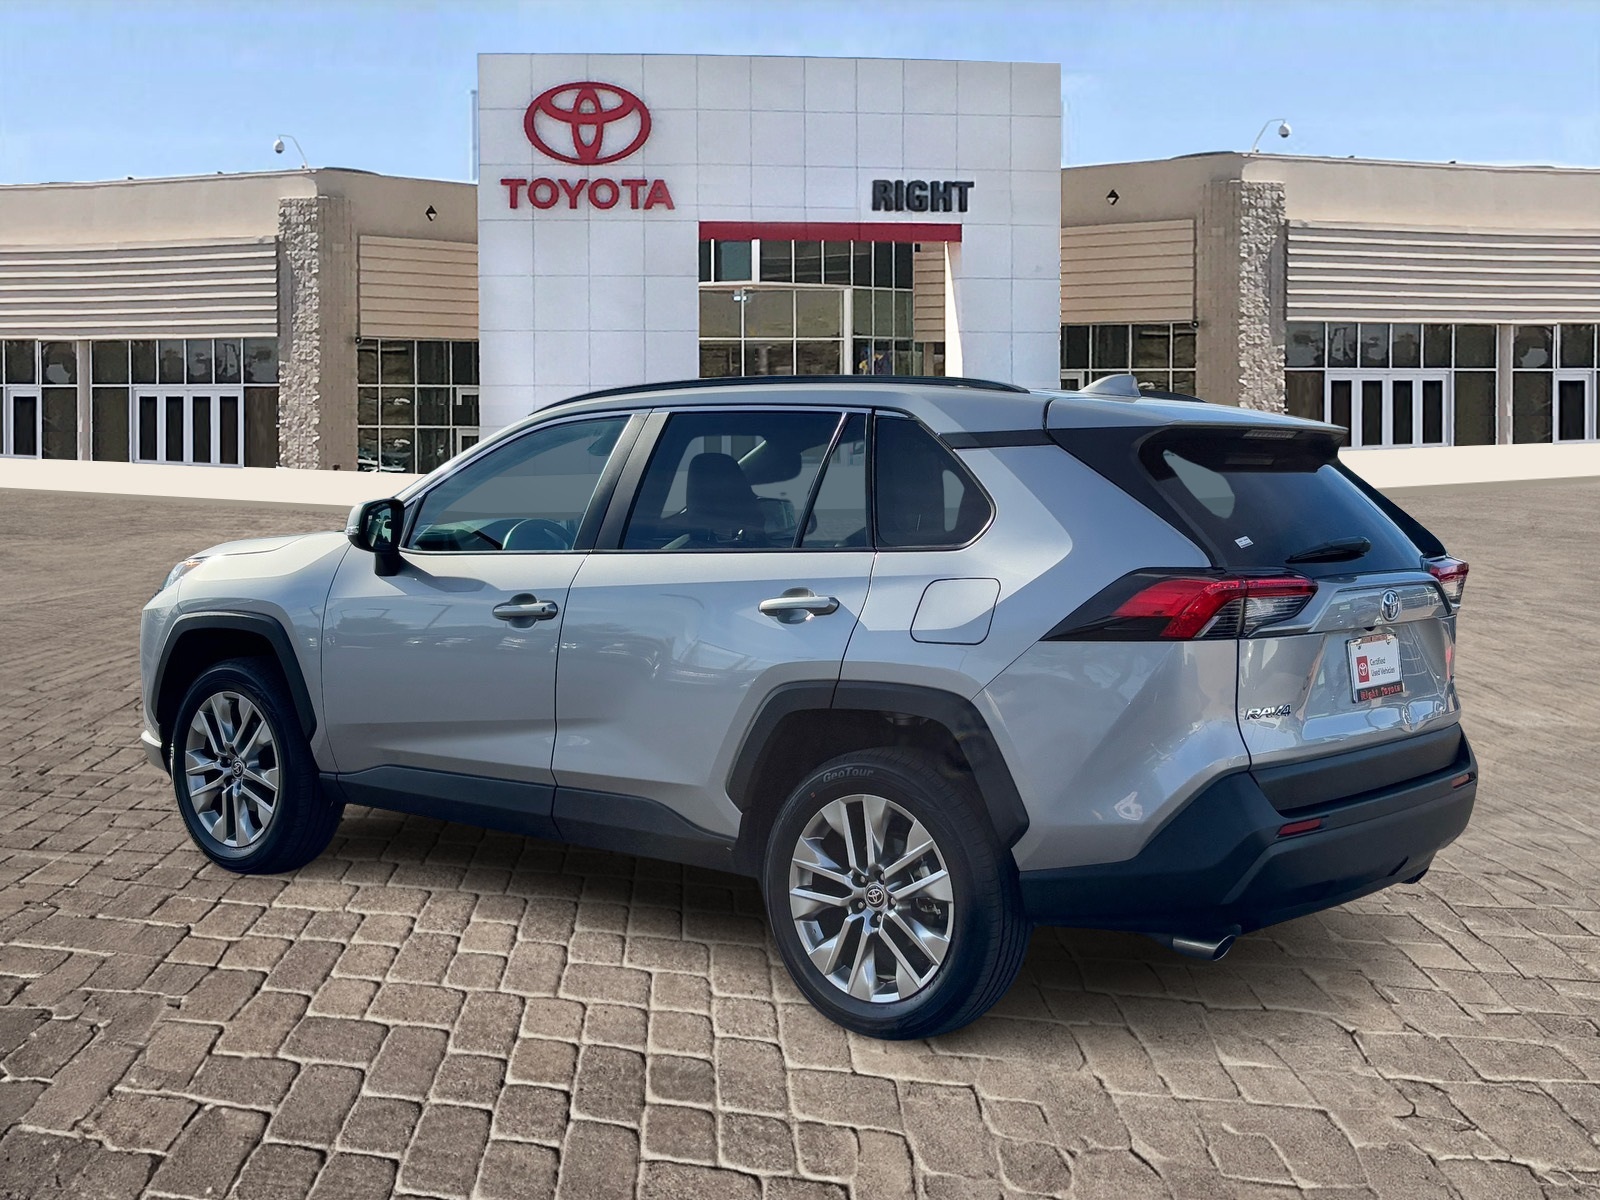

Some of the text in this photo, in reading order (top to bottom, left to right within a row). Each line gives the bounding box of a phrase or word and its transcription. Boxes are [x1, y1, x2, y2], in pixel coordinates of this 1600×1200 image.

[500, 178, 675, 209] TOYOTA
[872, 179, 975, 212] RIGHT
[1370, 657, 1386, 666] Certified
[1371, 666, 1396, 677] Used Vehicles
[1361, 685, 1401, 700] Right Toyota
[1245, 703, 1292, 720] RAV4
[823, 767, 874, 783] GeoTour
